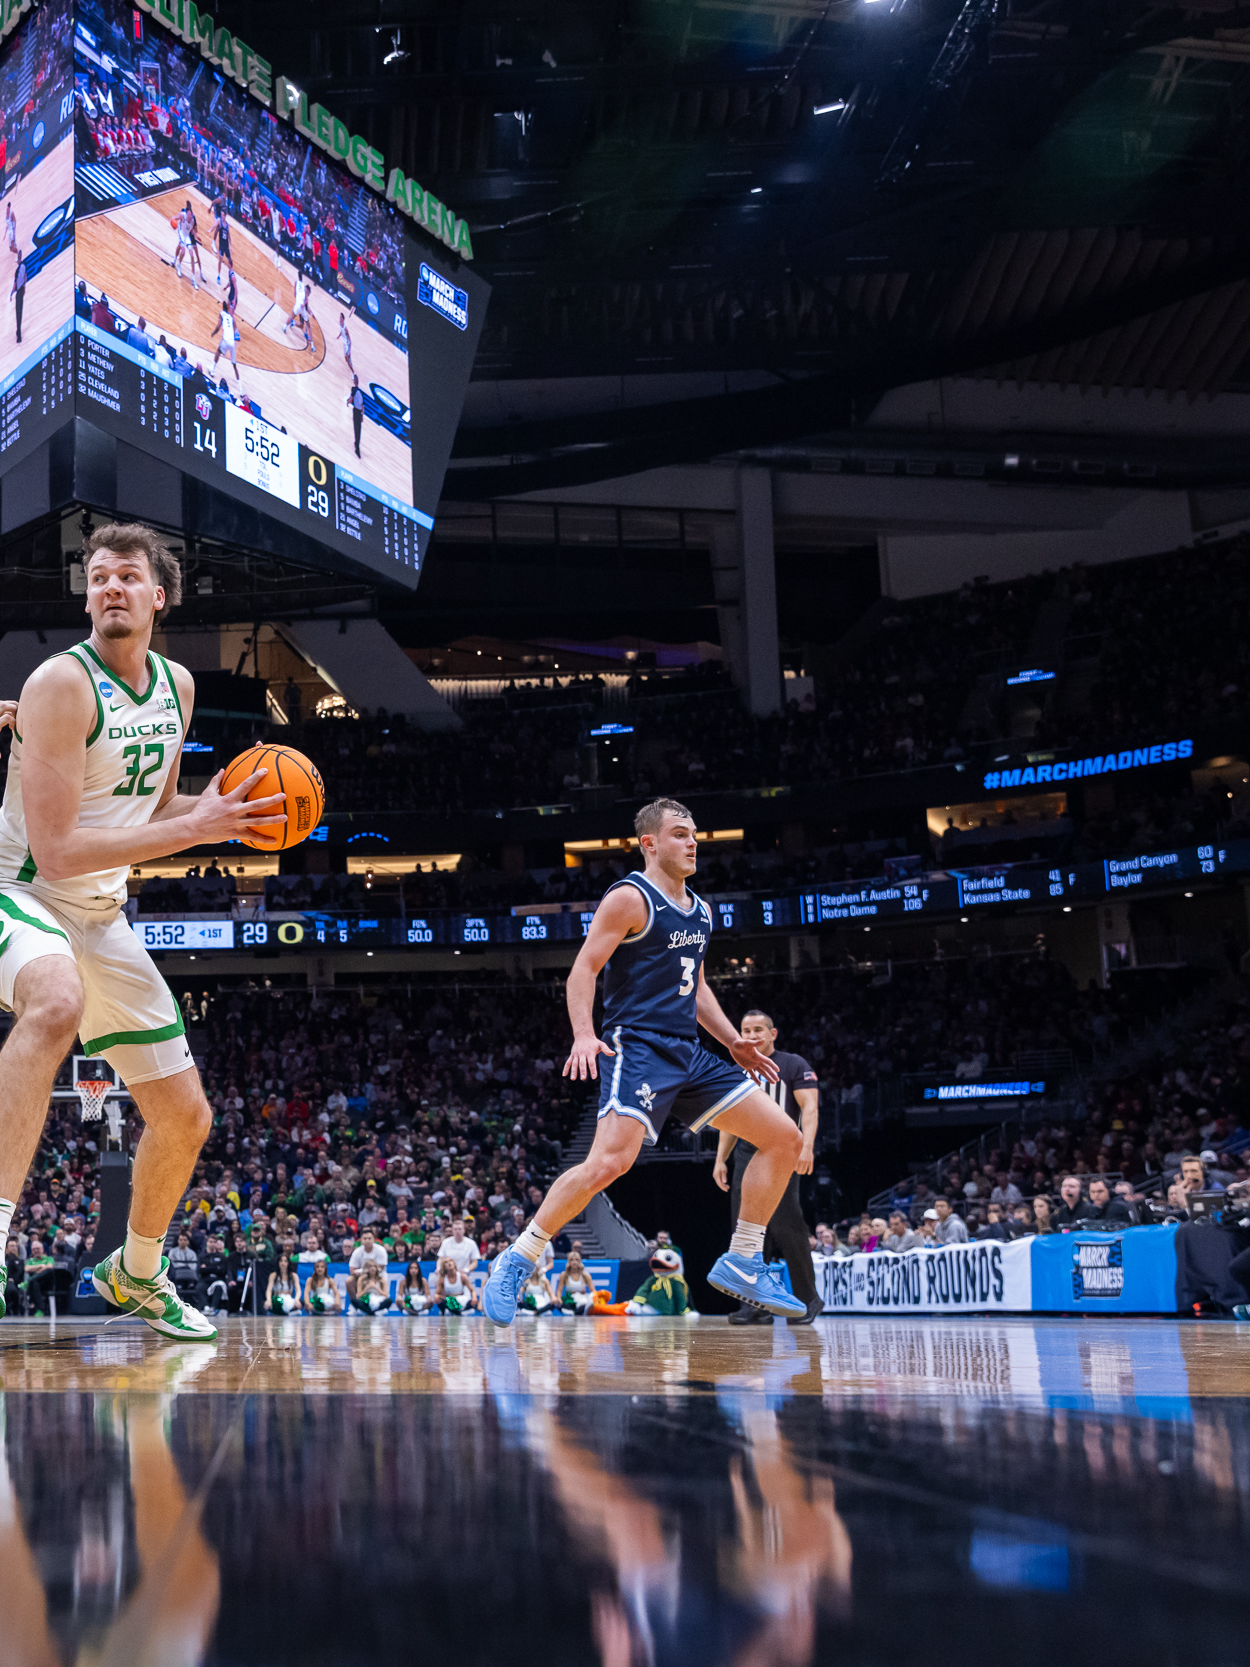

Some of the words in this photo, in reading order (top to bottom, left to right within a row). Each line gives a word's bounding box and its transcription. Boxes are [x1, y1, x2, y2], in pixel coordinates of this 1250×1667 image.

[276, 76, 385, 191] PLEDGE
[387, 168, 473, 260] ARENA
[429, 272, 455, 302] MARCH
[432, 289, 466, 324] MADNESS
[80, 322, 97, 337] PLAYER
[80, 335, 84, 344] 0
[88, 340, 110, 358] PORTER
[140, 369, 145, 378] 0
[153, 376, 157, 385] 1
[164, 382, 168, 391] 2
[175, 388, 179, 397] 1
[79, 359, 85, 370] 11
[88, 364, 105, 380] YATES
[140, 392, 145, 402] 0
[153, 399, 157, 408] 2
[164, 405, 168, 415] 0
[175, 411, 180, 420] 0
[80, 348, 84, 357] 3
[88, 352, 114, 372] METHENY
[140, 380, 145, 390] 3
[153, 388, 157, 396] 1
[164, 394, 168, 403] 0
[175, 400, 180, 409] 0
[78, 371, 86, 382] 25
[88, 376, 120, 399] CLEVELAND
[153, 411, 157, 420] 2
[175, 423, 180, 432] 0
[78, 383, 86, 394] 32
[154, 423, 157, 432] 1
[164, 429, 169, 438] 0
[175, 435, 180, 444] 0
[256, 420, 268, 435] 1ST
[193, 421, 218, 459] 14
[245, 427, 280, 468] 5:52
[307, 484, 329, 518] 29
[109, 723, 177, 739] DUCKS
[112, 743, 164, 796] 32
[984, 739, 1193, 790] #MARCHMADNESS
[1109, 856, 1140, 873] Grand
[1141, 852, 1178, 869] Canyon
[1197, 845, 1214, 859] 60
[1218, 850, 1226, 863] F
[963, 876, 1005, 891] Fairfield
[1049, 869, 1061, 882] 41
[1068, 873, 1076, 886] F
[1110, 872, 1143, 888] Baylor
[1200, 860, 1215, 874] 73
[761, 901, 773, 911] TO
[821, 891, 859, 906] Stephen
[861, 890, 868, 902] F.
[870, 887, 901, 900] Austin
[904, 886, 918, 898] 54
[922, 889, 929, 902] F
[963, 889, 1001, 905] Kansas
[1001, 888, 1030, 901] State
[719, 904, 734, 914] BLK
[763, 911, 773, 926] 3
[822, 906, 848, 920] Notre
[850, 904, 877, 917] Dame
[903, 898, 923, 912] 106
[412, 919, 427, 928] FG%
[466, 919, 485, 928] 3PT%
[526, 916, 541, 925] FT%
[723, 914, 732, 928] 0
[144, 925, 185, 945] 5:52
[207, 928, 222, 939] 1ST
[242, 923, 267, 944] 29
[317, 930, 325, 943] 4
[339, 930, 347, 943] 5
[407, 929, 433, 942] 50.0
[464, 928, 489, 941] 50.0
[522, 926, 547, 940] 83.3
[668, 930, 706, 953] Liberty
[679, 957, 695, 996] 3
[938, 1081, 1031, 1100] MARCHMADNESS
[1079, 1246, 1110, 1267] MARCH
[822, 1260, 854, 1306] FIRST
[865, 1254, 920, 1305] SECOND
[926, 1246, 1004, 1304] ROUNDS
[1082, 1267, 1124, 1289] MADNESS
